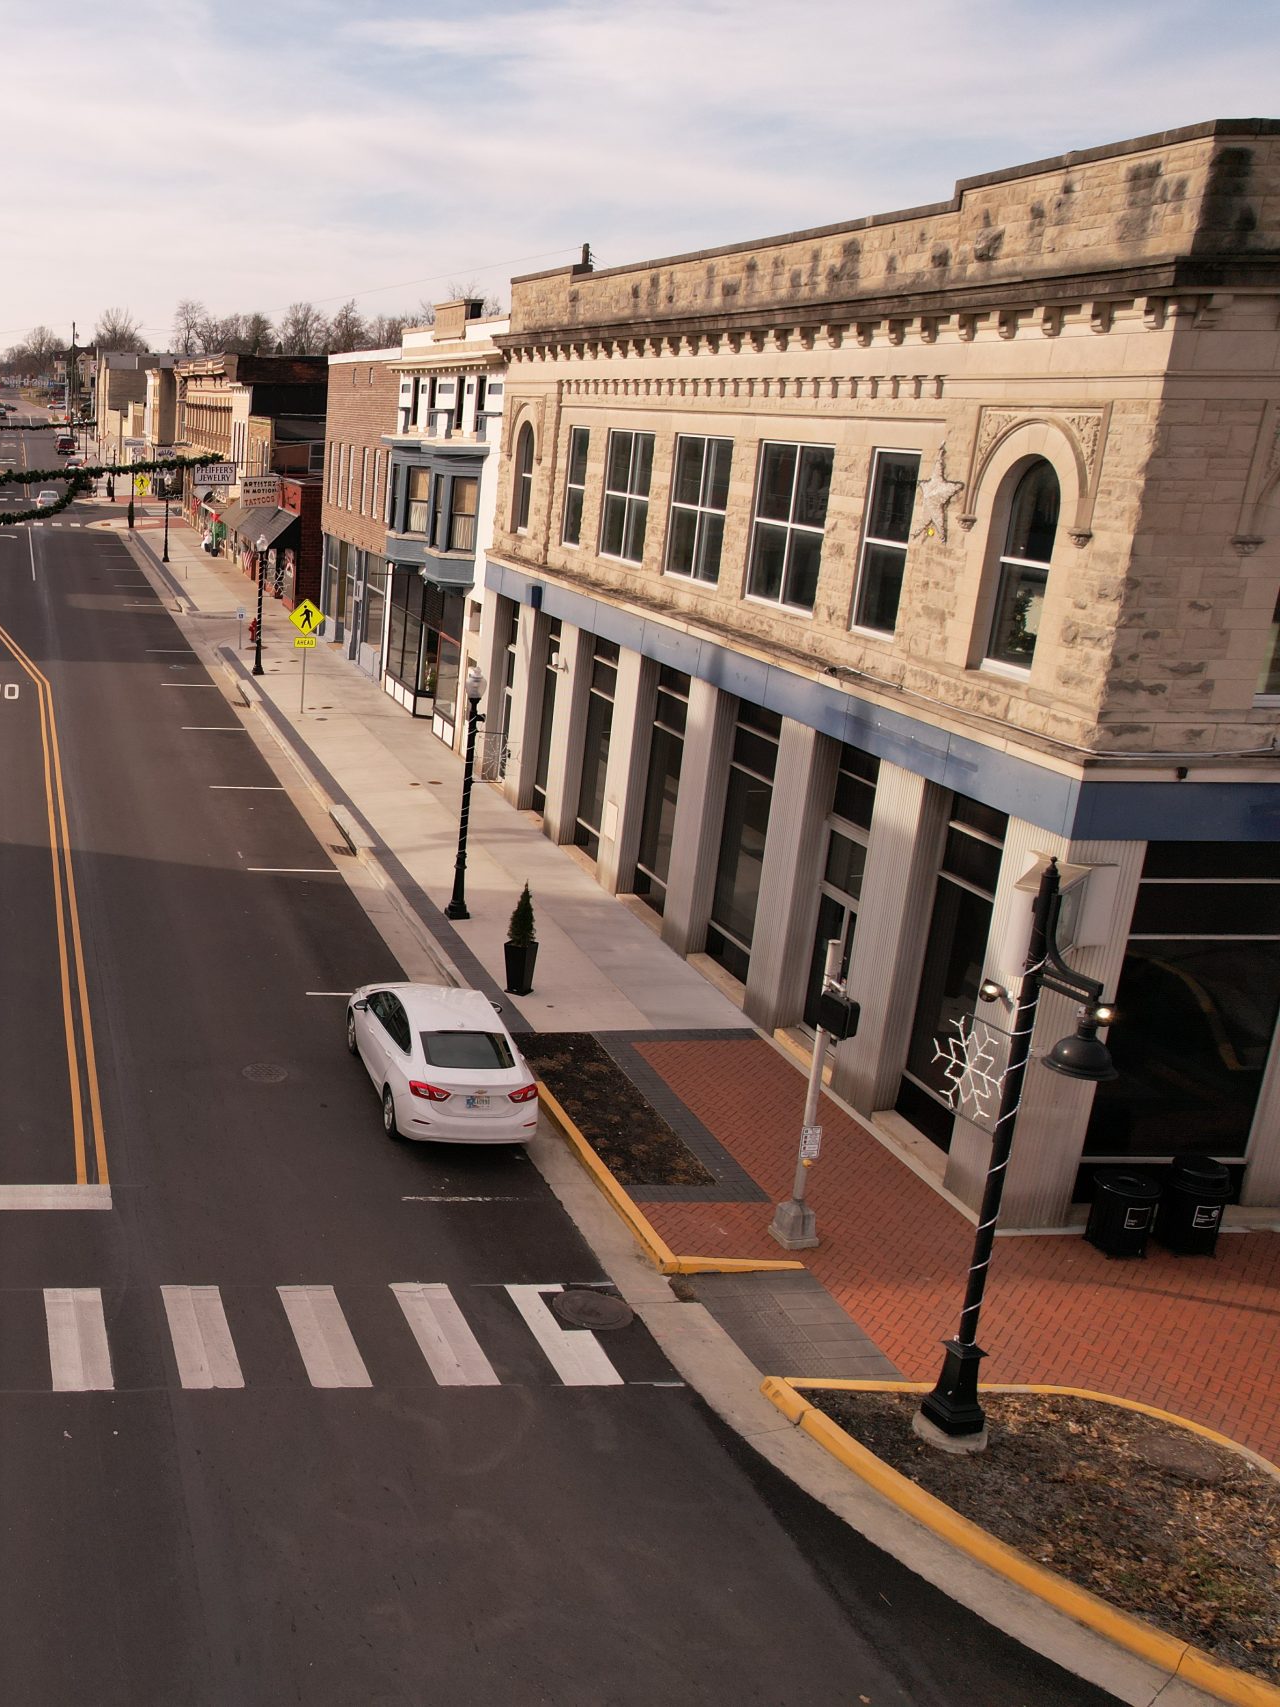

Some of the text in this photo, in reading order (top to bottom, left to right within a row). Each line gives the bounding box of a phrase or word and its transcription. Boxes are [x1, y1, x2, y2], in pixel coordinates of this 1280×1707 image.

[196, 466, 233, 474] PFEIFFER'S
[199, 474, 231, 482] JEWELRY
[243, 495, 274, 506] TATTOOS
